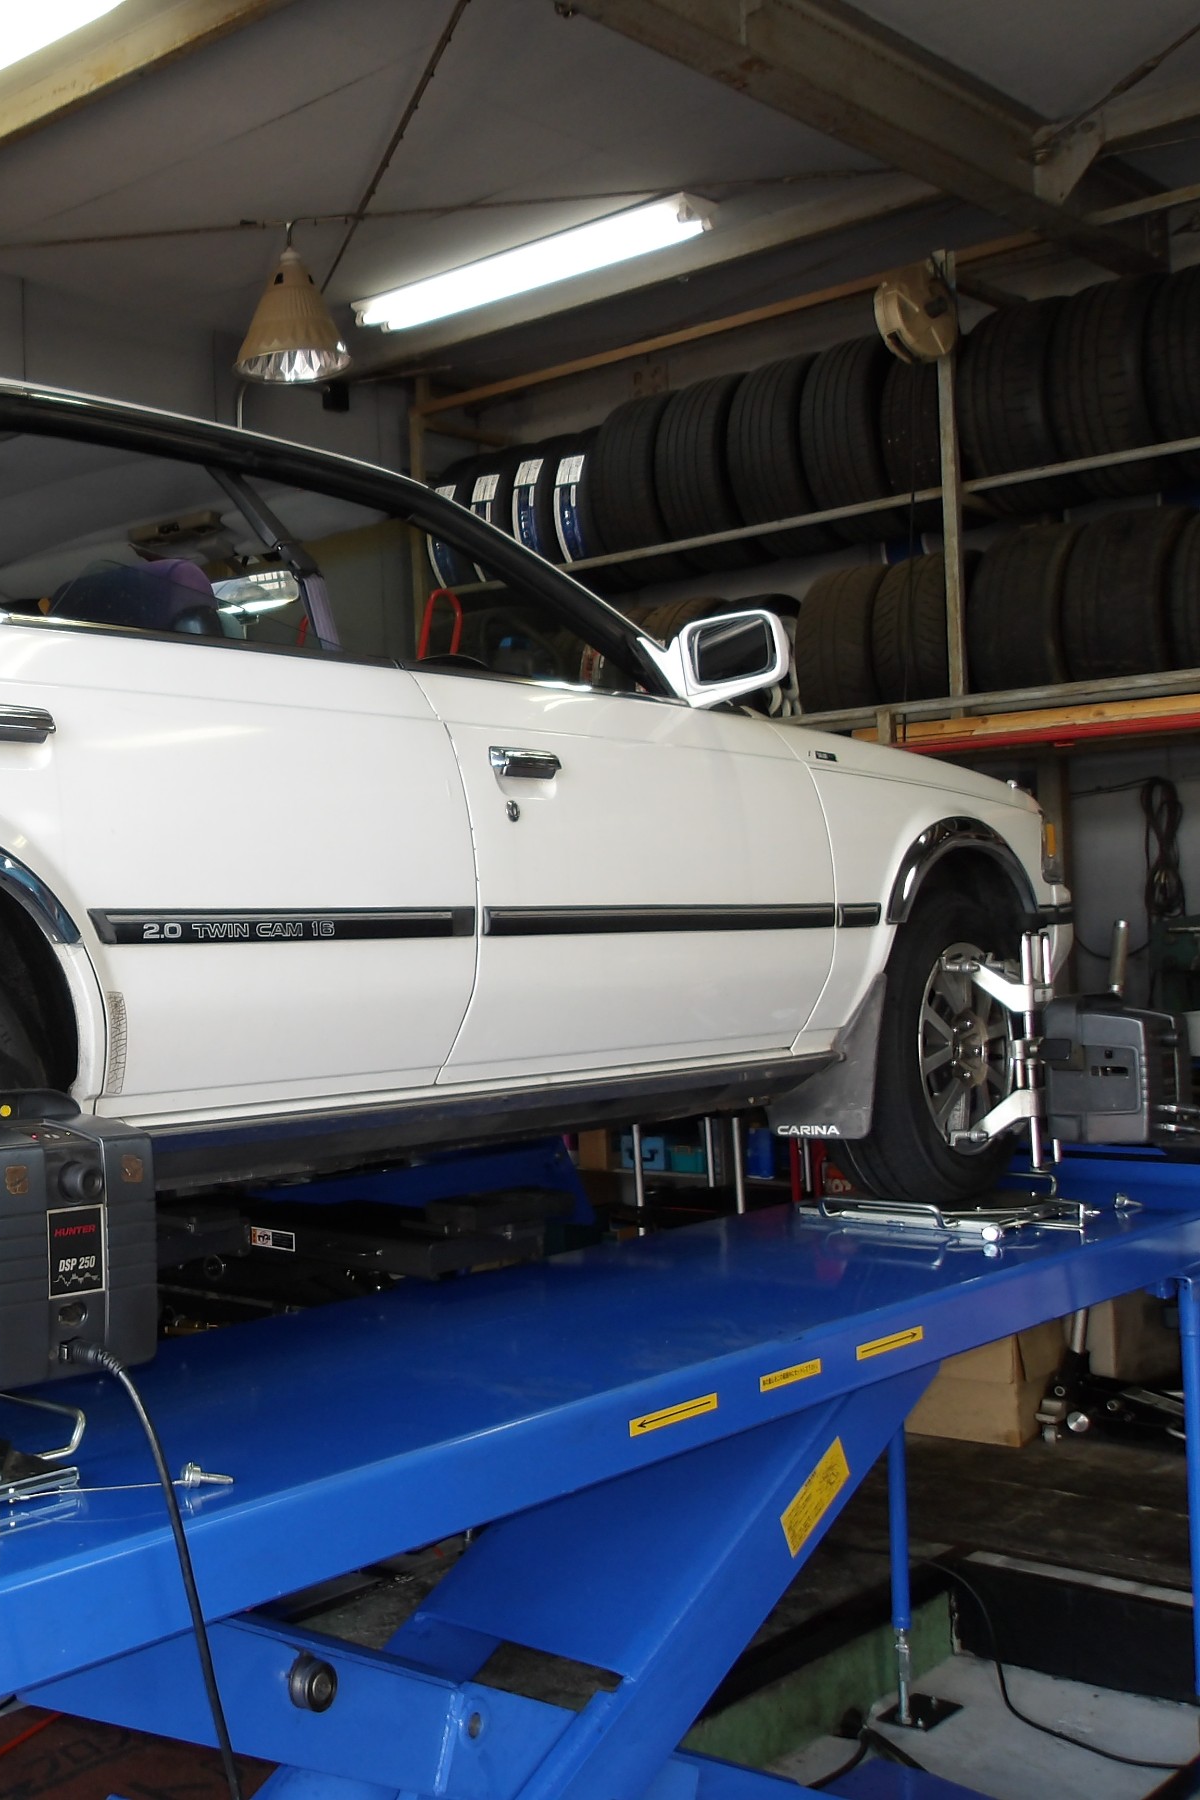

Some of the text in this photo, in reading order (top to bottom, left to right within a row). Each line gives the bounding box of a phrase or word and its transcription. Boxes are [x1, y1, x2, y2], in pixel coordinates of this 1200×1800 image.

[143, 921, 335, 939] 2.0 TWIN CAM 16
[777, 1125, 840, 1135] CARINA
[54, 1224, 97, 1237] HUNTER
[59, 1255, 95, 1272] DSP 250
